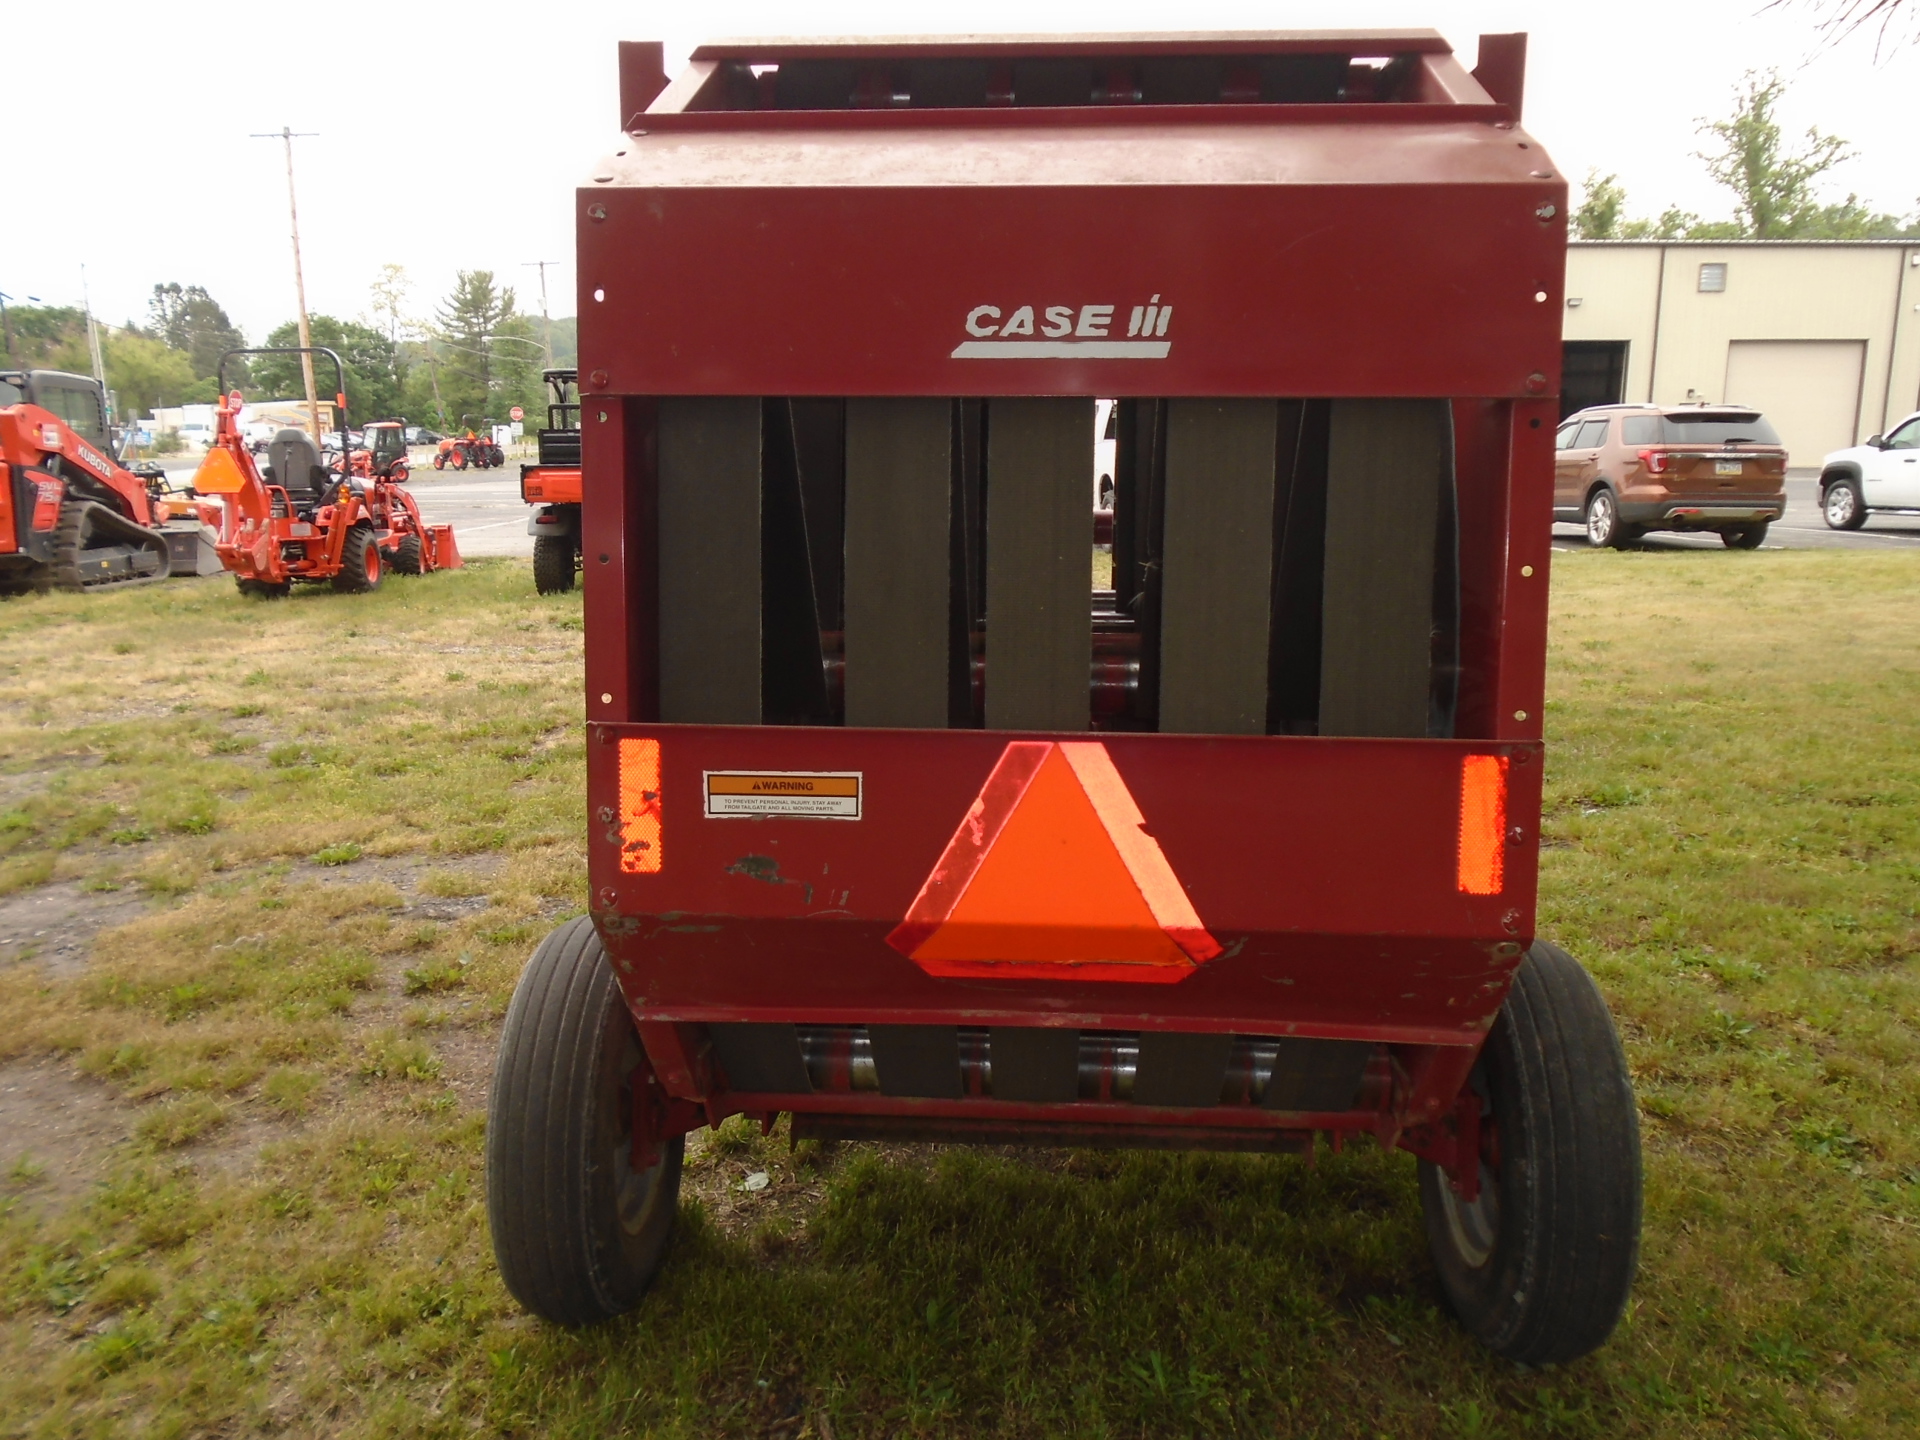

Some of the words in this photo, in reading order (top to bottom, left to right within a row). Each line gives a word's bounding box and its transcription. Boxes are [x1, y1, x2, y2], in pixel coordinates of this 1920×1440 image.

[965, 304, 1115, 338] CASE
[230, 397, 243, 409] STOP
[77, 444, 112, 479] KUBOTA
[38, 481, 61, 491] SVL
[761, 781, 814, 791] WARNING
